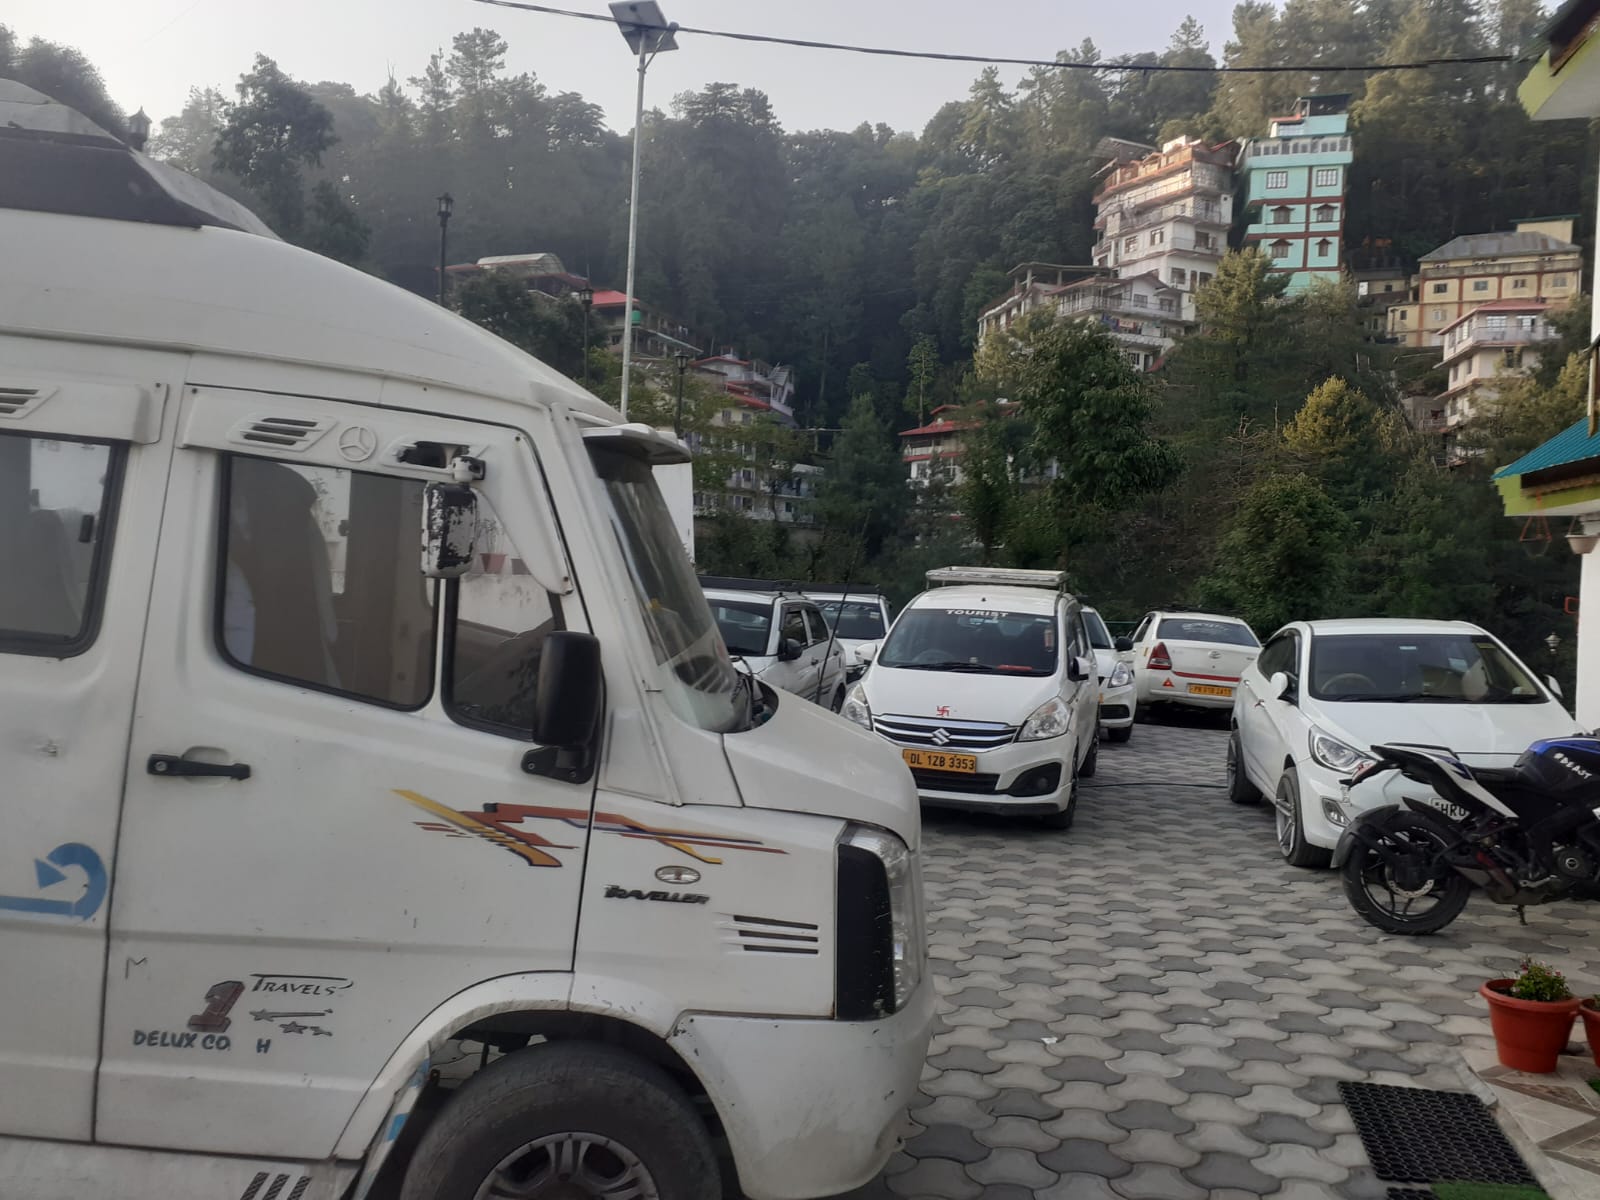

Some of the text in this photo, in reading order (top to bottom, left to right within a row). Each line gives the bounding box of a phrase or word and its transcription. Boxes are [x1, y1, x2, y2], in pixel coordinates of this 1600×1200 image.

[946, 609, 1009, 618] TOURIST
[910, 753, 922, 765] DL
[949, 757, 975, 770] 3353
[133, 1029, 198, 1049] DELUX
